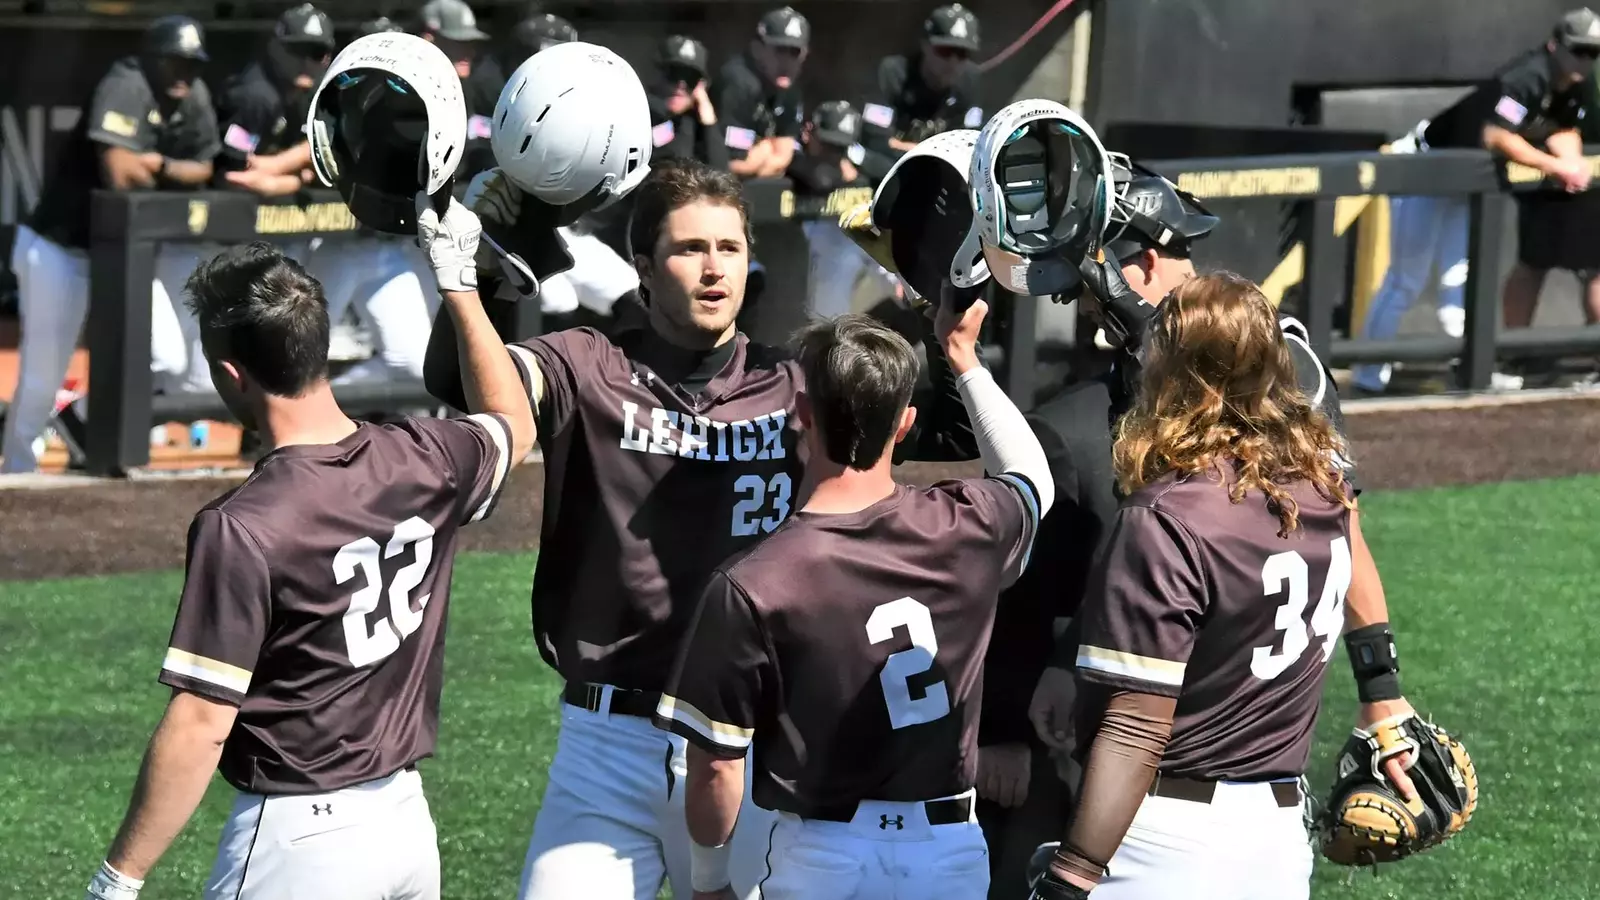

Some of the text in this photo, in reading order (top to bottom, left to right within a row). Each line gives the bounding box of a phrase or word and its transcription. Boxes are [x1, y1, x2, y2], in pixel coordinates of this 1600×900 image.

[620, 400, 787, 461] LEHIGH
[731, 472, 792, 537] 23
[332, 516, 436, 668] 22
[1250, 536, 1352, 680] 34
[865, 596, 951, 730] 2
